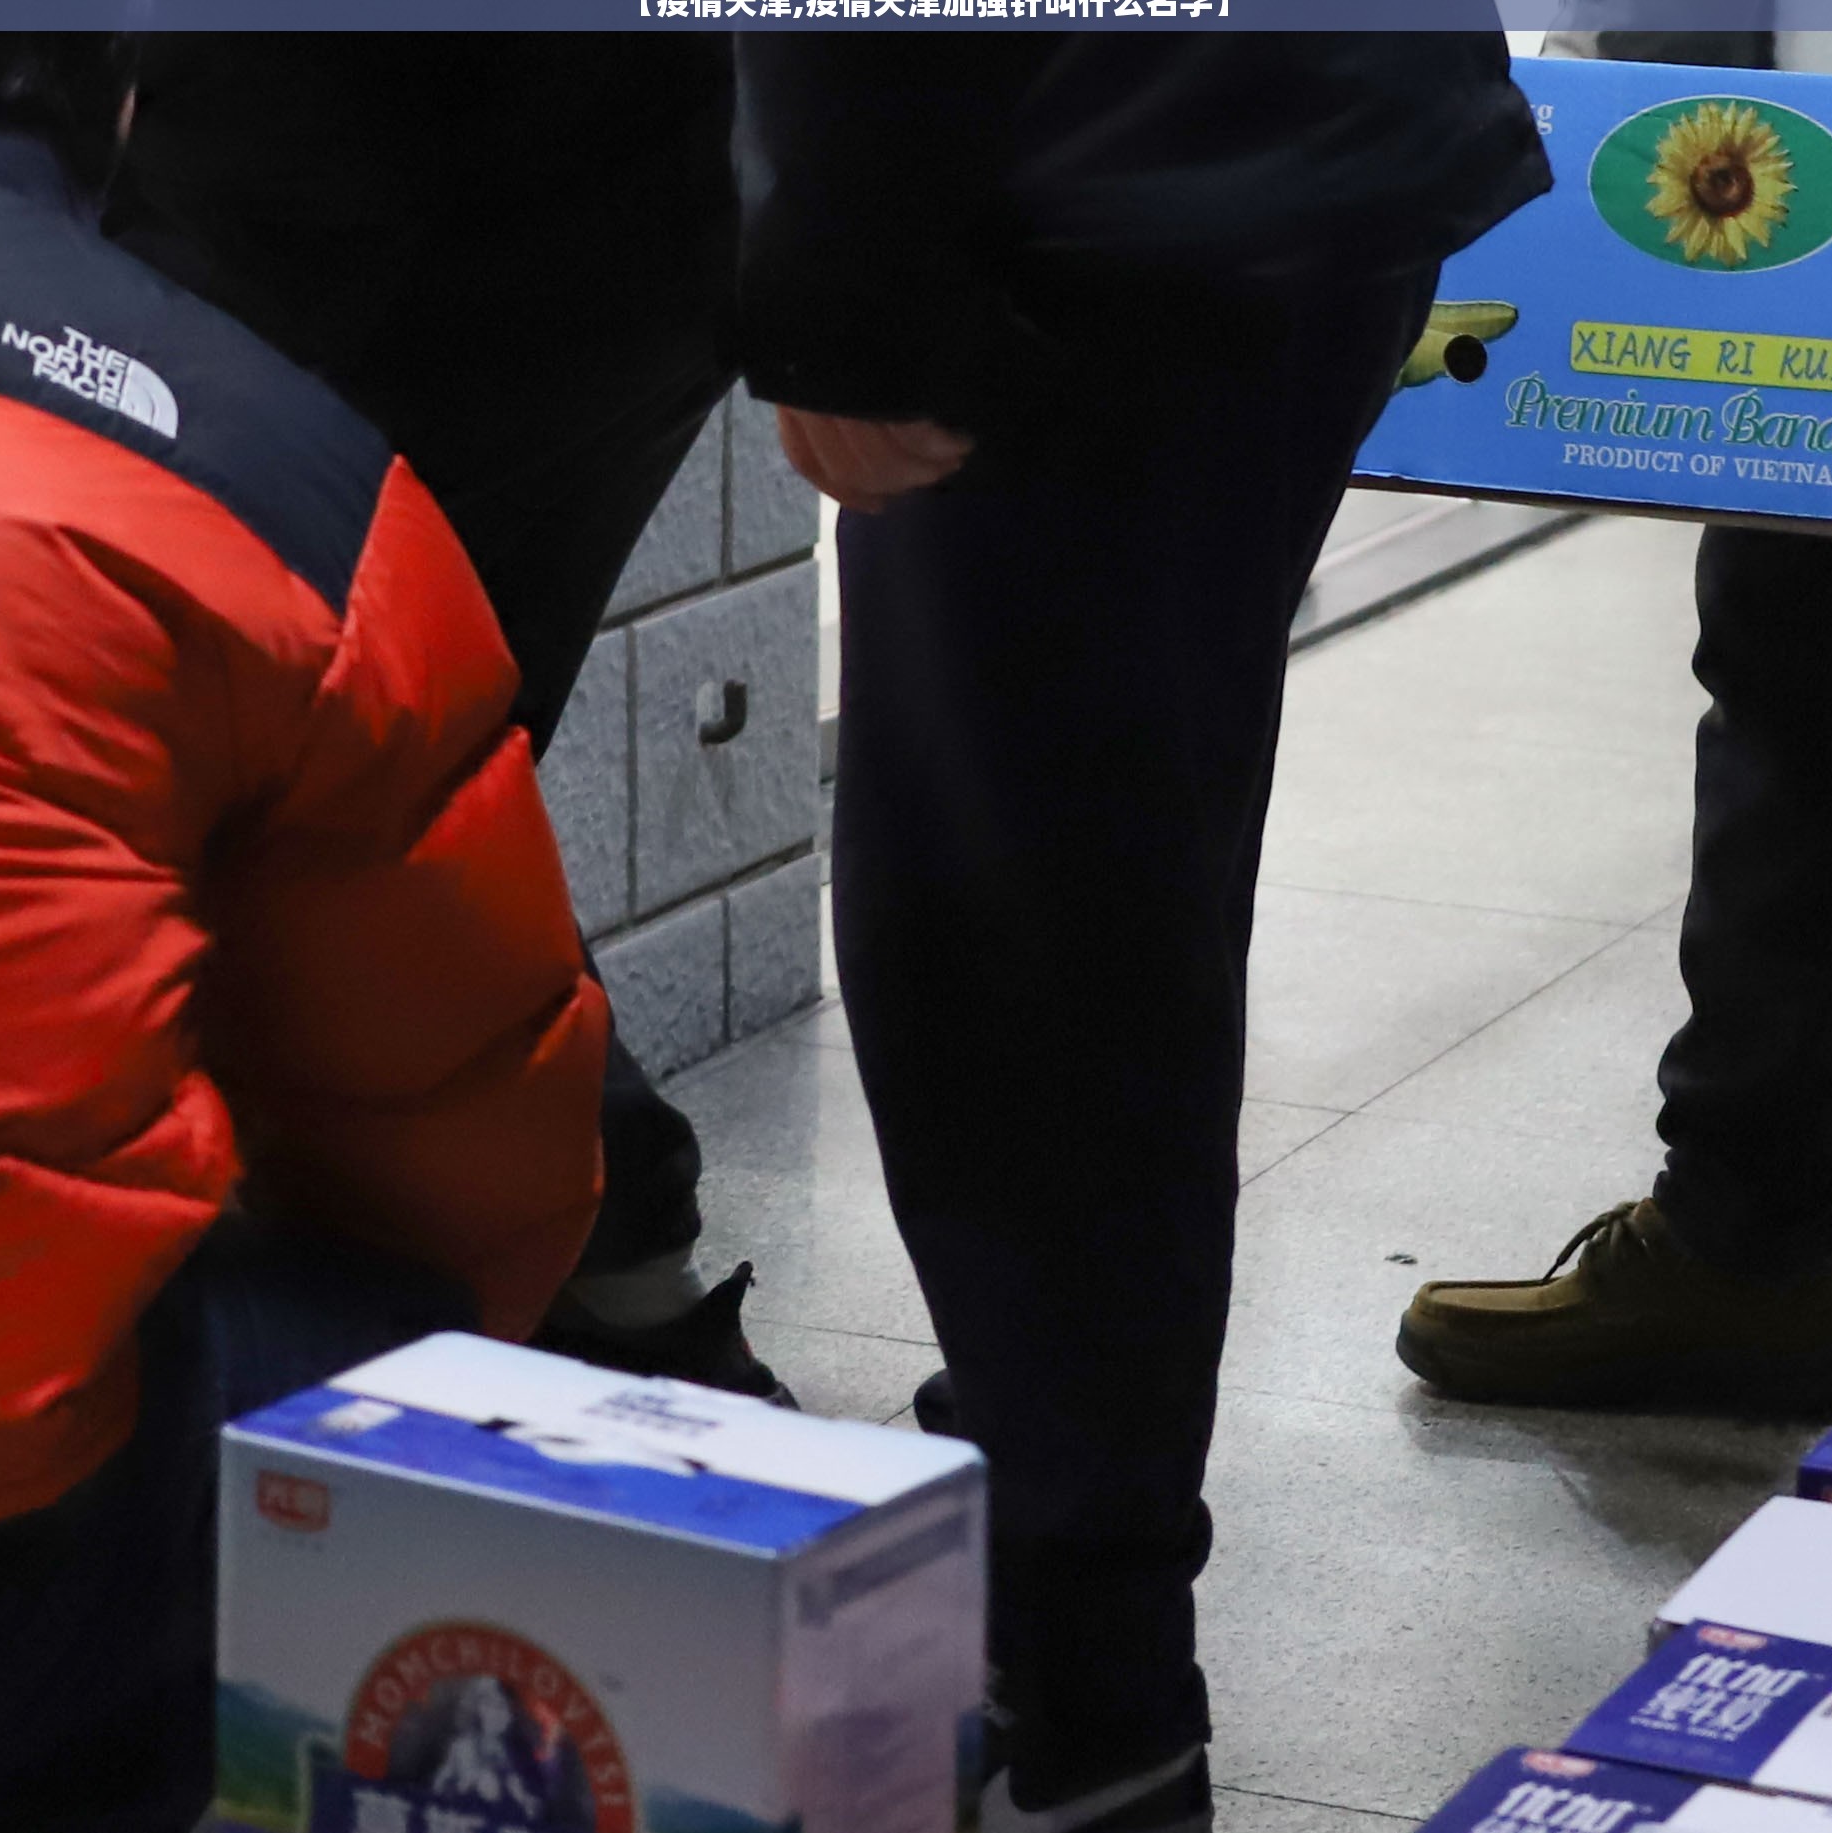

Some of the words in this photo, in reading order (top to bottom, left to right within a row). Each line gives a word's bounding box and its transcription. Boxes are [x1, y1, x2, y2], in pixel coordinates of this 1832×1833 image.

[1, 320, 128, 395] NORTH
[63, 324, 130, 368] THE
[1574, 329, 1692, 372] XIANG
[1717, 339, 1756, 376] RI
[32, 356, 122, 410] FACE
[1504, 370, 1716, 444] Premium
[1562, 442, 1684, 473] PRODUCT
[1689, 453, 1726, 477] OF
